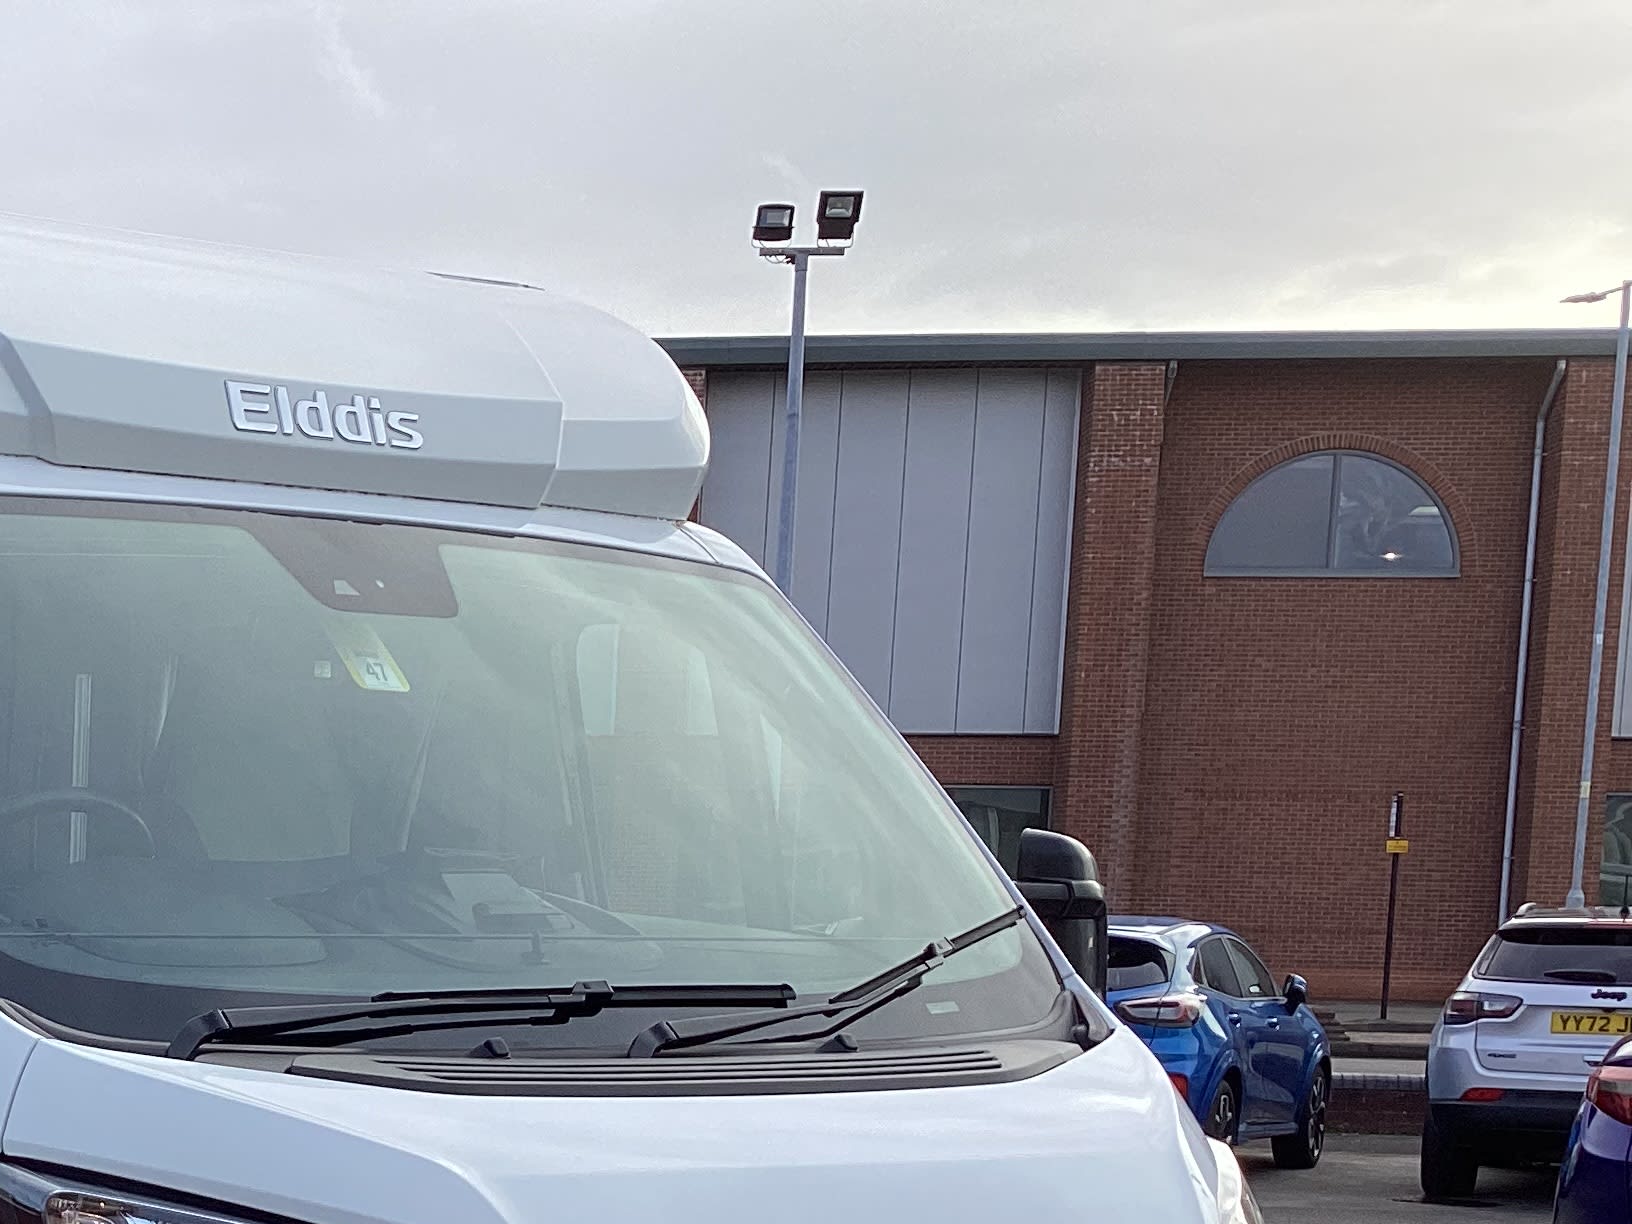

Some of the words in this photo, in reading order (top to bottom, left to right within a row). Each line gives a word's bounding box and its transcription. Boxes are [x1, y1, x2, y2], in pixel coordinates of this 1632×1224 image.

[224, 379, 424, 450] Elddis
[1591, 989, 1628, 1002] Jeep
[1560, 1015, 1610, 1032] YY72
